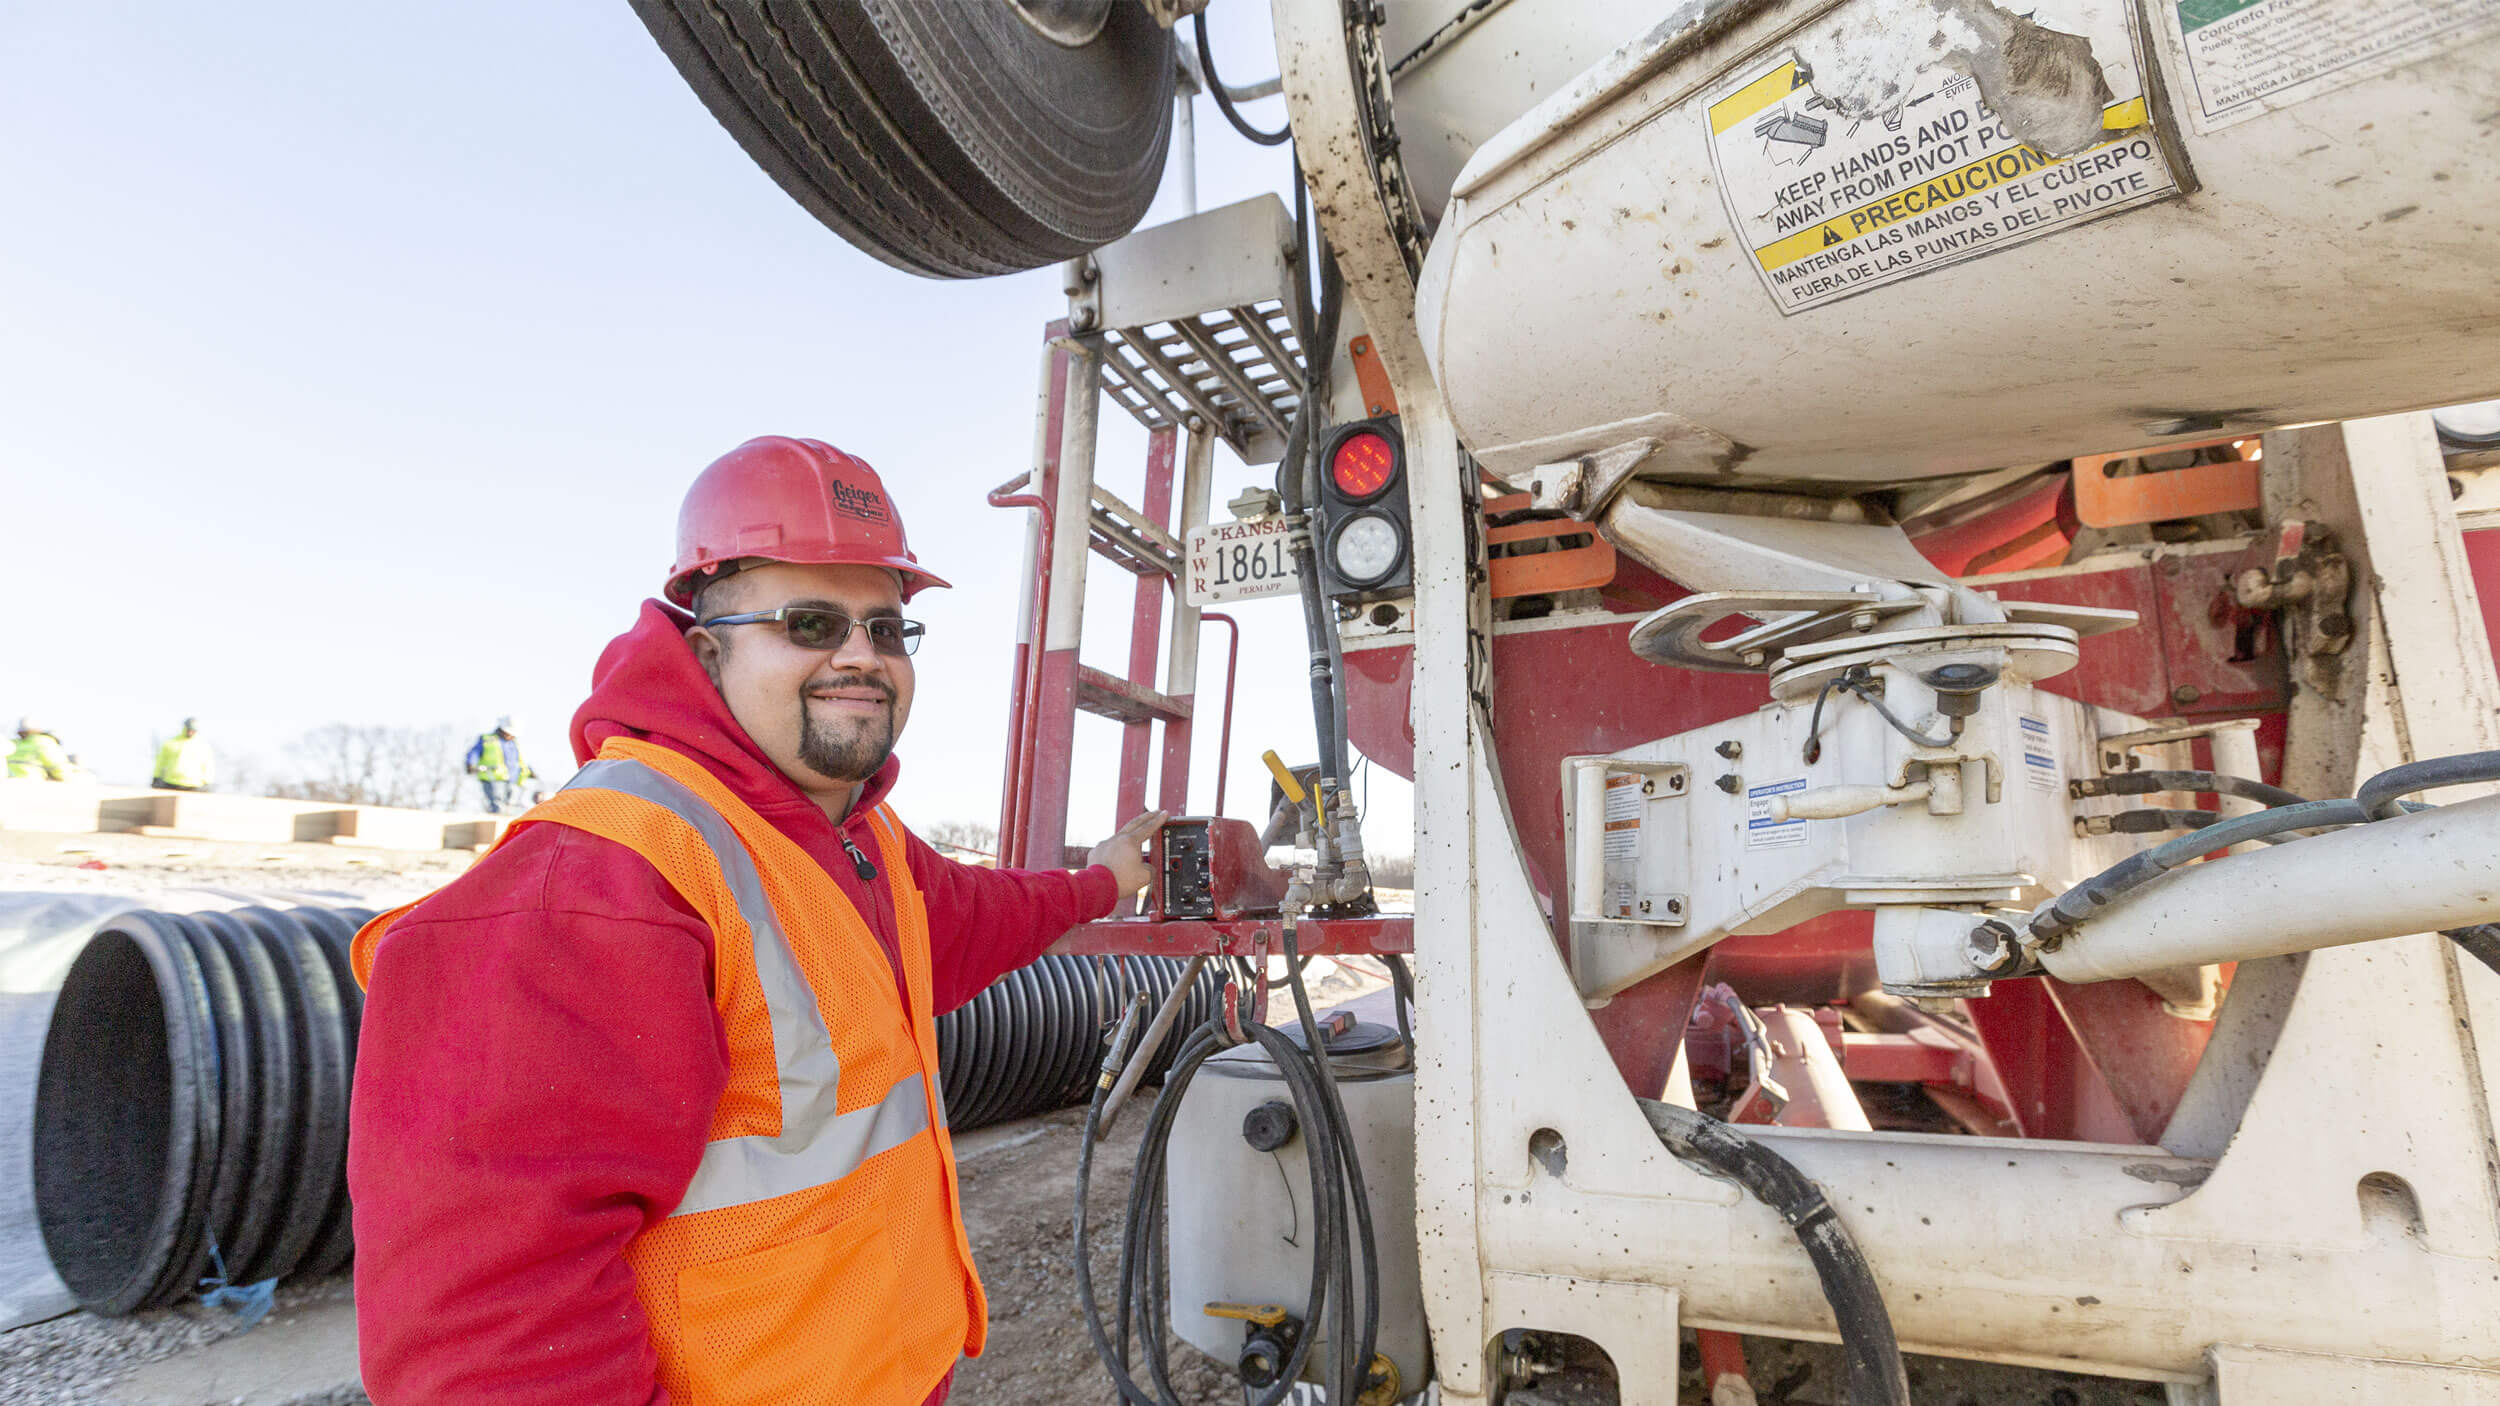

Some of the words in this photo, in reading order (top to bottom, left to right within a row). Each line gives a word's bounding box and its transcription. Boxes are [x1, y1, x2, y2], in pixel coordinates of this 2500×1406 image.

[2198, 9, 2265, 42] Concreto
[1942, 72, 1967, 89] AVO
[1944, 79, 1973, 99] EVITE
[2215, 79, 2278, 107] MANTENGA
[1774, 171, 1826, 208] KEEP
[1831, 135, 1911, 184] HANDS
[1918, 109, 1969, 149] AND
[1776, 196, 1825, 233] AWAY
[1830, 168, 1895, 208] FROM
[1898, 135, 1969, 181] PIVOT
[1850, 147, 2046, 234] PRECAUCION
[1773, 243, 1865, 285] MANTENGA
[1865, 228, 1903, 252] LAS
[1905, 200, 1983, 238] MANOS
[1985, 191, 2000, 210] Y
[2006, 182, 2039, 204] EL
[2042, 140, 2151, 191] CUERPO
[1792, 273, 1847, 300] FUERA
[1847, 263, 1874, 281] DE
[1874, 250, 1912, 272] LAS
[1914, 221, 1998, 259] PUNTAS
[2001, 206, 2051, 232] DEL
[2053, 171, 2149, 215] PIVOTE
[1220, 519, 1288, 541] KANSA
[1213, 538, 1301, 586] 1861
[1239, 585, 1264, 595] PERM
[1265, 582, 1282, 592] APP
